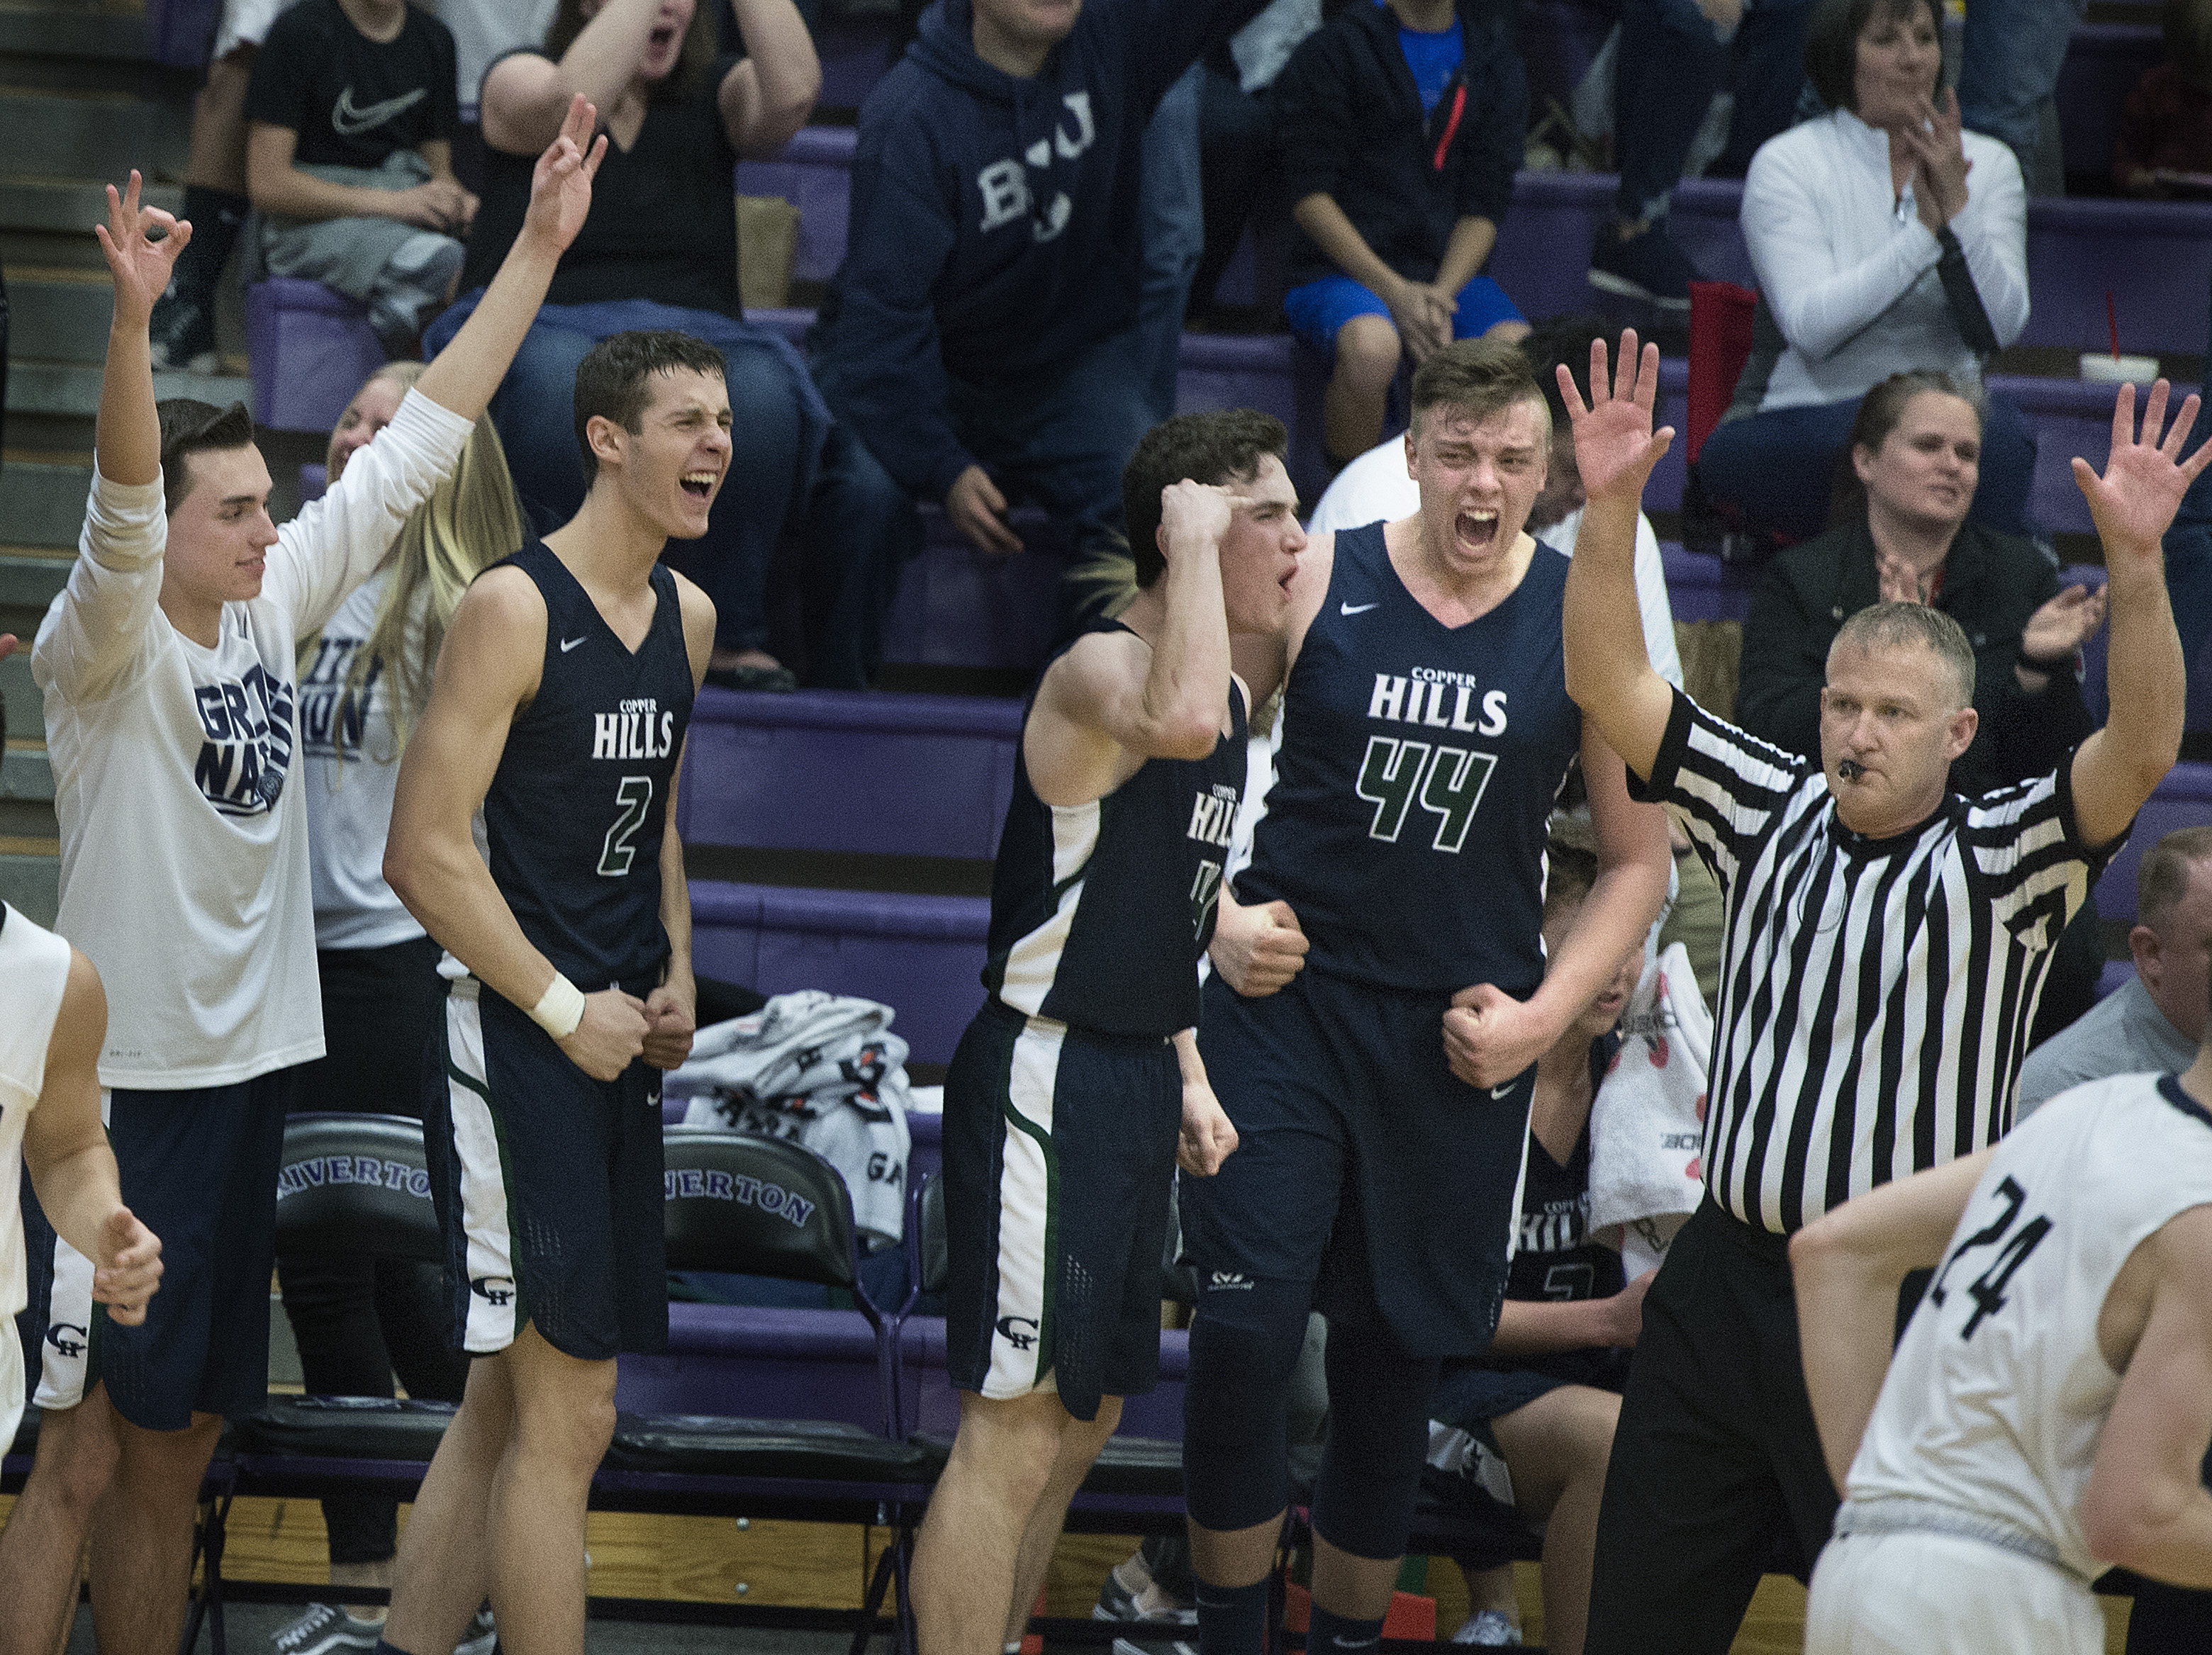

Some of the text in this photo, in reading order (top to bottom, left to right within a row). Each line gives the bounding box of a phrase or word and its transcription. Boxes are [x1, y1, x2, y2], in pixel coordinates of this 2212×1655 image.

[620, 698, 657, 713] COPPER
[1367, 673, 1507, 737] HILLS
[1411, 667, 1477, 688] COPPER
[592, 711, 673, 759] HILLS
[1355, 736, 1499, 854] 44
[596, 775, 653, 877] 2
[276, 1155, 435, 1201] IVERTO
[1931, 1174, 2054, 1341] 24
